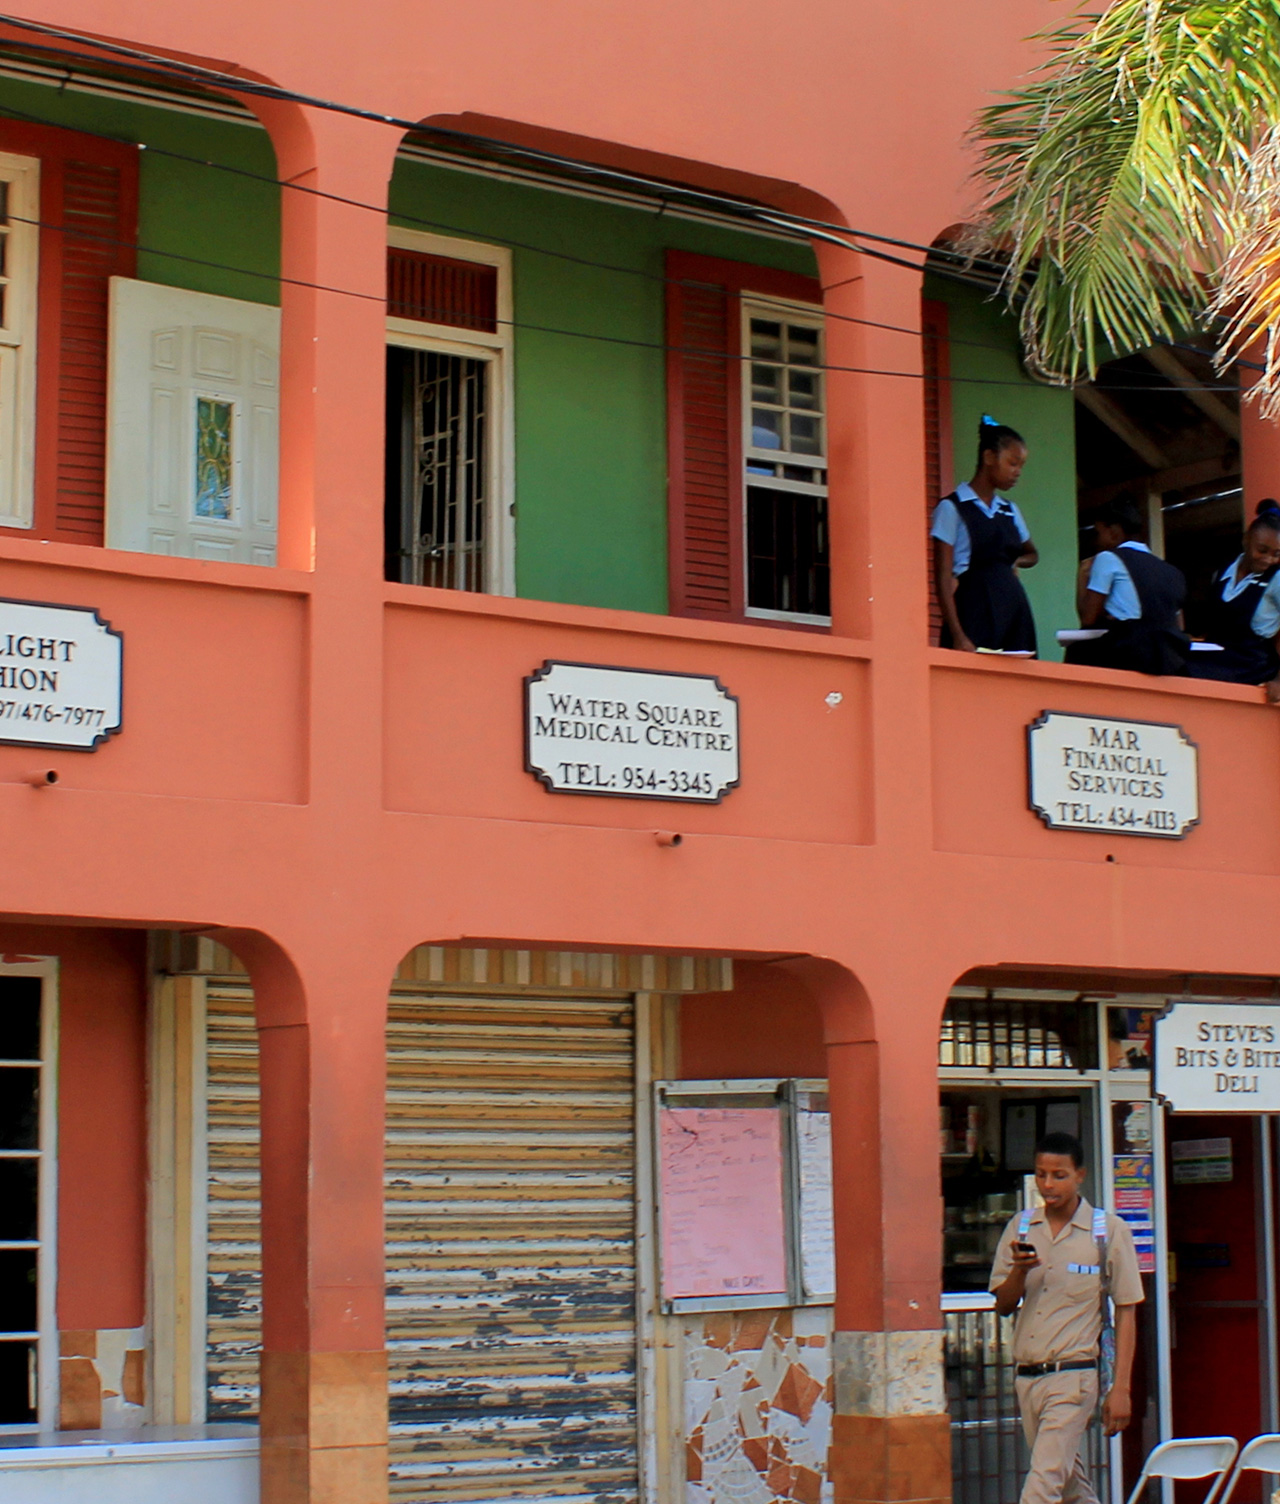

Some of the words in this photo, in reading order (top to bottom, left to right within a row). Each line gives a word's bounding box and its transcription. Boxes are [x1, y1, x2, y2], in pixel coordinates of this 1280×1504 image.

[547, 692, 630, 721] WATER
[635, 701, 723, 729] SQUARE
[534, 715, 639, 744] MEDICAL
[645, 724, 734, 752] CENTRE
[1088, 726, 1141, 751] MAR
[1061, 746, 1168, 777] FINANCIAL
[558, 762, 617, 787] TEL:
[622, 766, 712, 794] 954-3345
[1067, 770, 1165, 799] SERVICES
[1056, 801, 1104, 824] TEL:
[1107, 806, 1177, 831] 434-4113
[1197, 1021, 1275, 1043] STEVE'S
[1175, 1046, 1219, 1068] BITS
[1223, 1048, 1239, 1067] &
[1215, 1073, 1259, 1094] DELI
